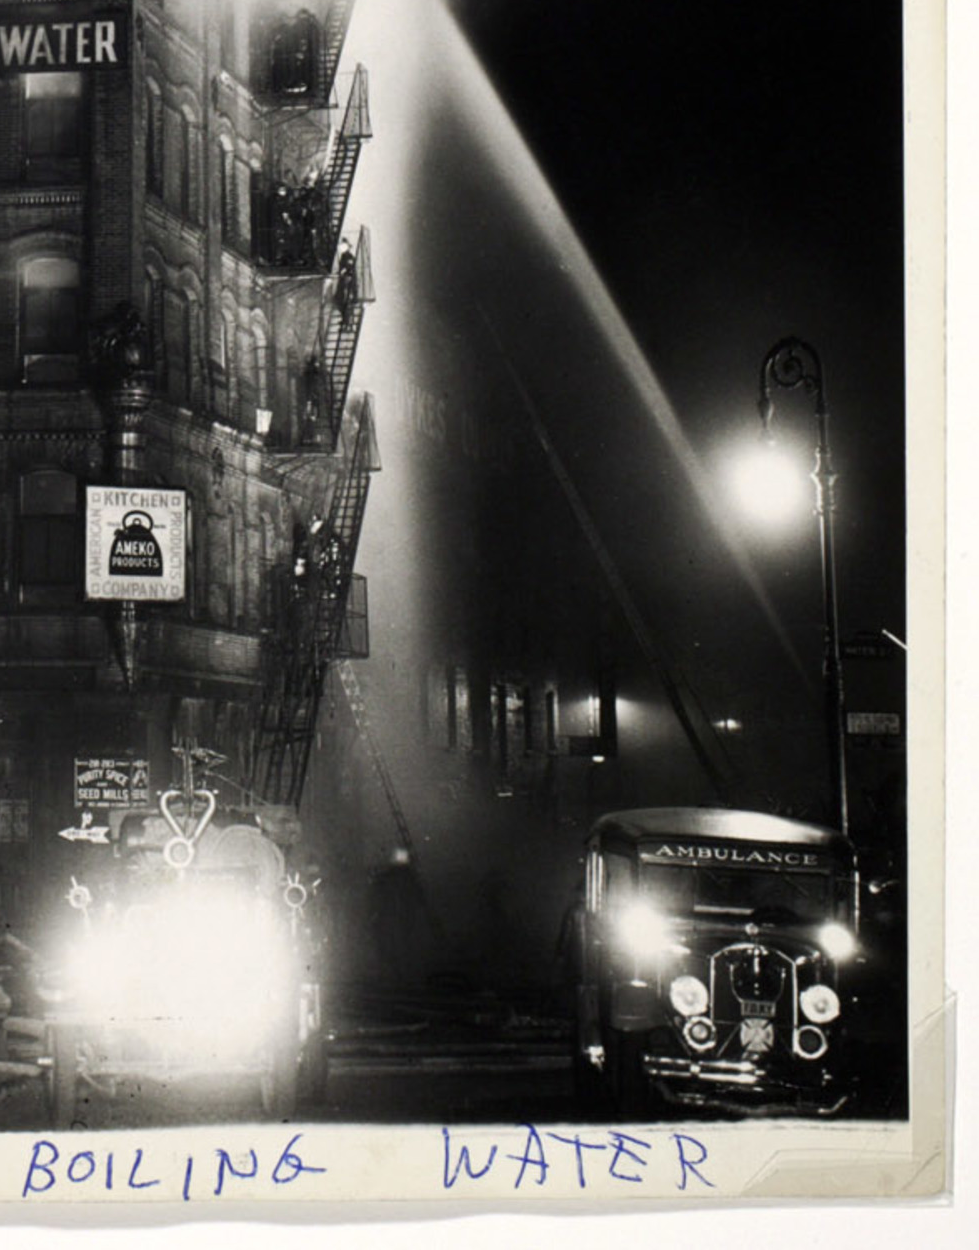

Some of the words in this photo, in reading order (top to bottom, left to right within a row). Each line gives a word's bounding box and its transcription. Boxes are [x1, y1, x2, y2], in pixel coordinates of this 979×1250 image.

[103, 491, 169, 508] KITCHEN
[89, 508, 102, 577] AMERICAN
[115, 540, 155, 556] AMEKO
[169, 511, 182, 580] PRODUCTS
[111, 557, 159, 568] PRODUCTS
[102, 581, 169, 598] COMPANY
[77, 788, 100, 800] SEED
[102, 788, 129, 801] MILLS
[654, 843, 818, 866] AMBULANCE
[21, 1134, 327, 1201] BOILING
[441, 1123, 717, 1191] WATER
